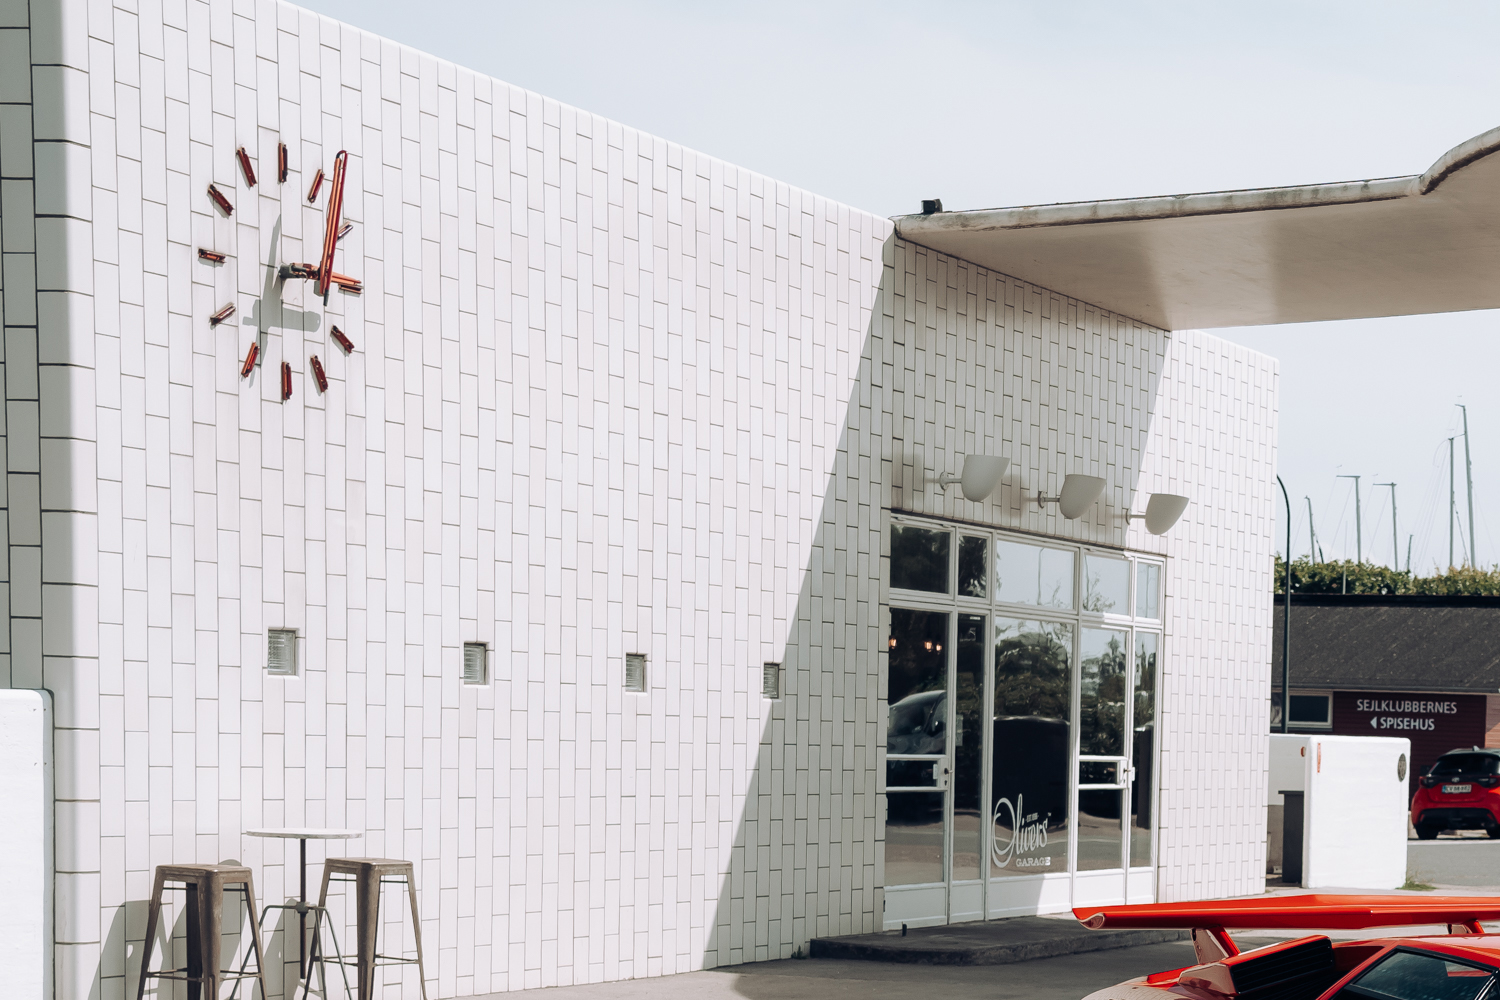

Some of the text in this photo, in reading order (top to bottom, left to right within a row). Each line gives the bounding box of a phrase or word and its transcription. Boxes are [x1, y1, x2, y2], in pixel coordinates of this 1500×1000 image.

[1357, 699, 1457, 714] SEJLKLUBBERNES
[1380, 717, 1435, 731] SPISEHUS
[1016, 856, 1051, 867] GARAGE
